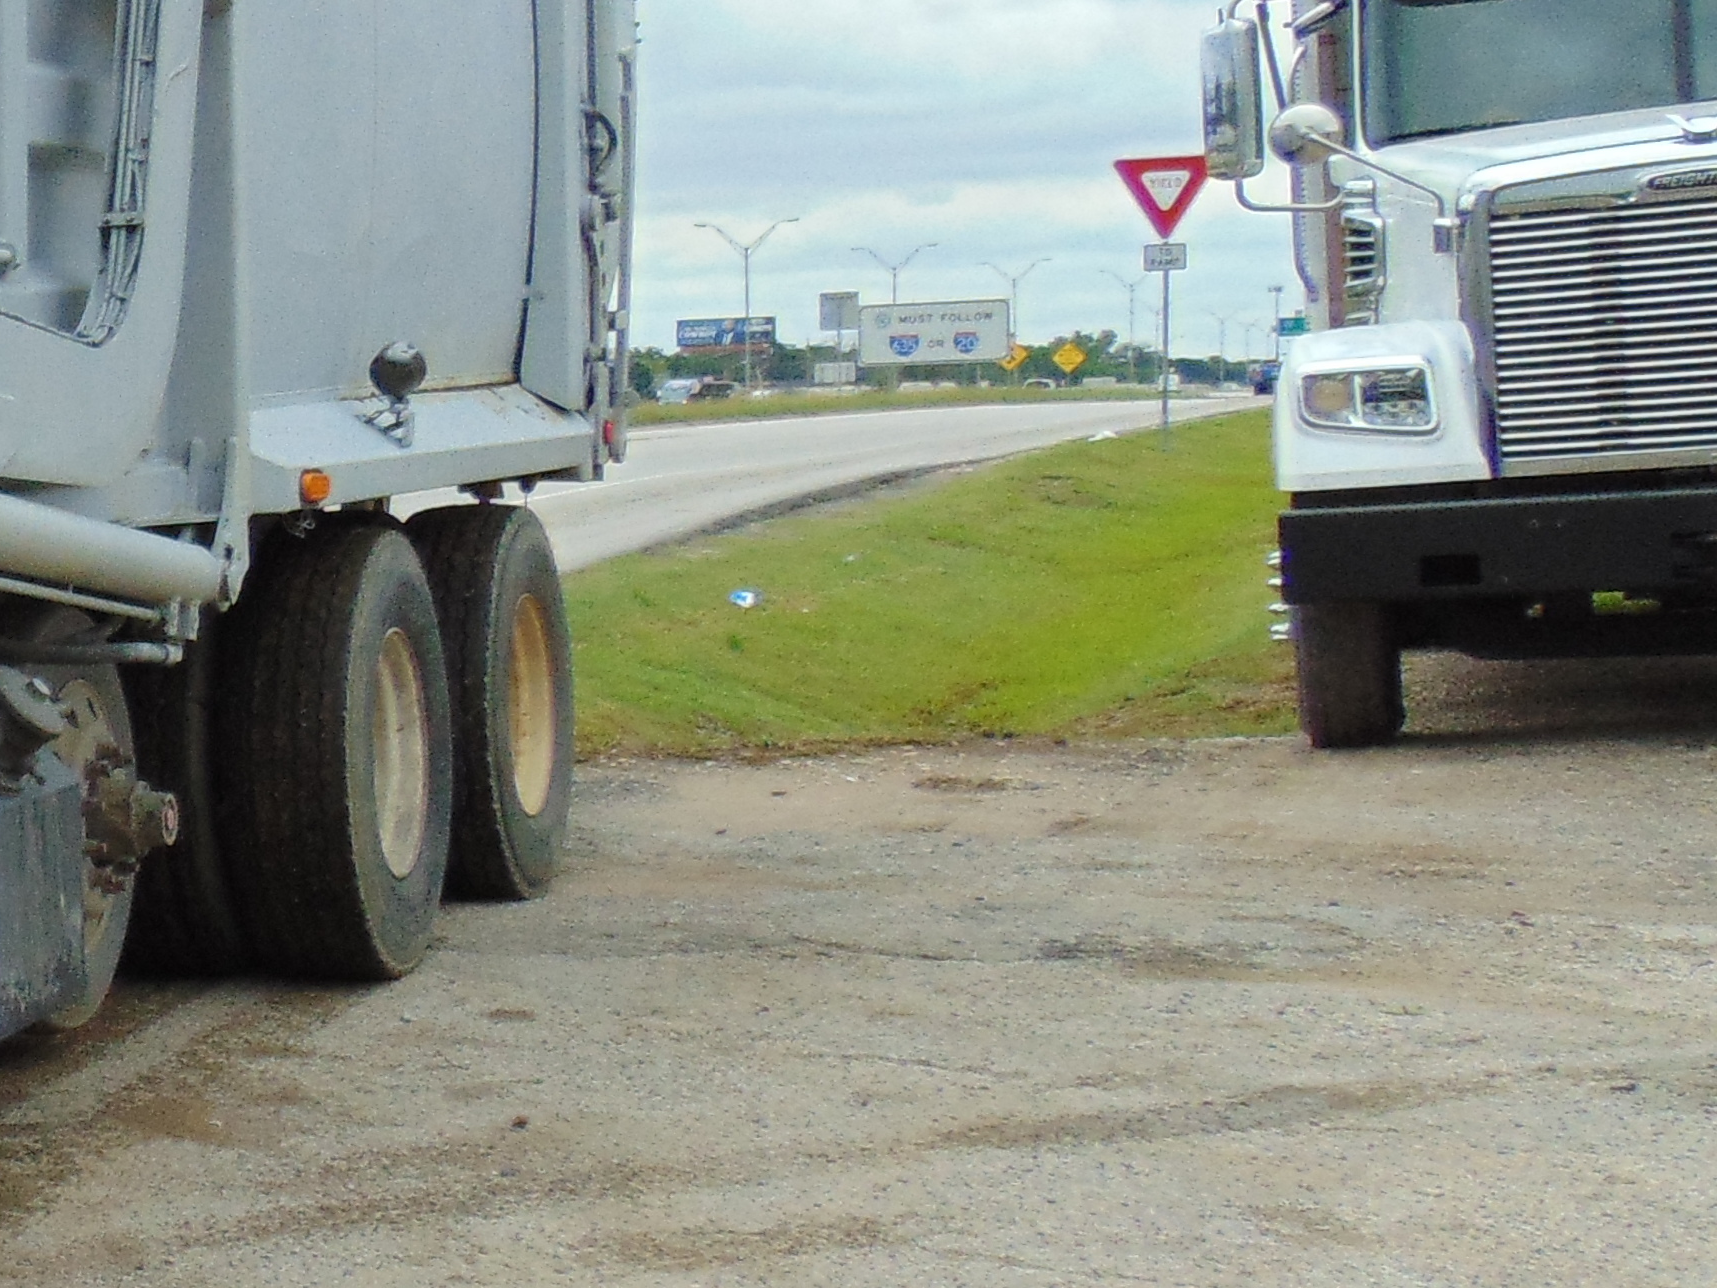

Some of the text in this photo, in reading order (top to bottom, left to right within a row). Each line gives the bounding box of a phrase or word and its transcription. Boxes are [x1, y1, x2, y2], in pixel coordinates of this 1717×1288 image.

[898, 313, 933, 324] MUST
[940, 312, 993, 322] FOLLOW
[926, 339, 944, 349] OR
[956, 336, 977, 351] 20
